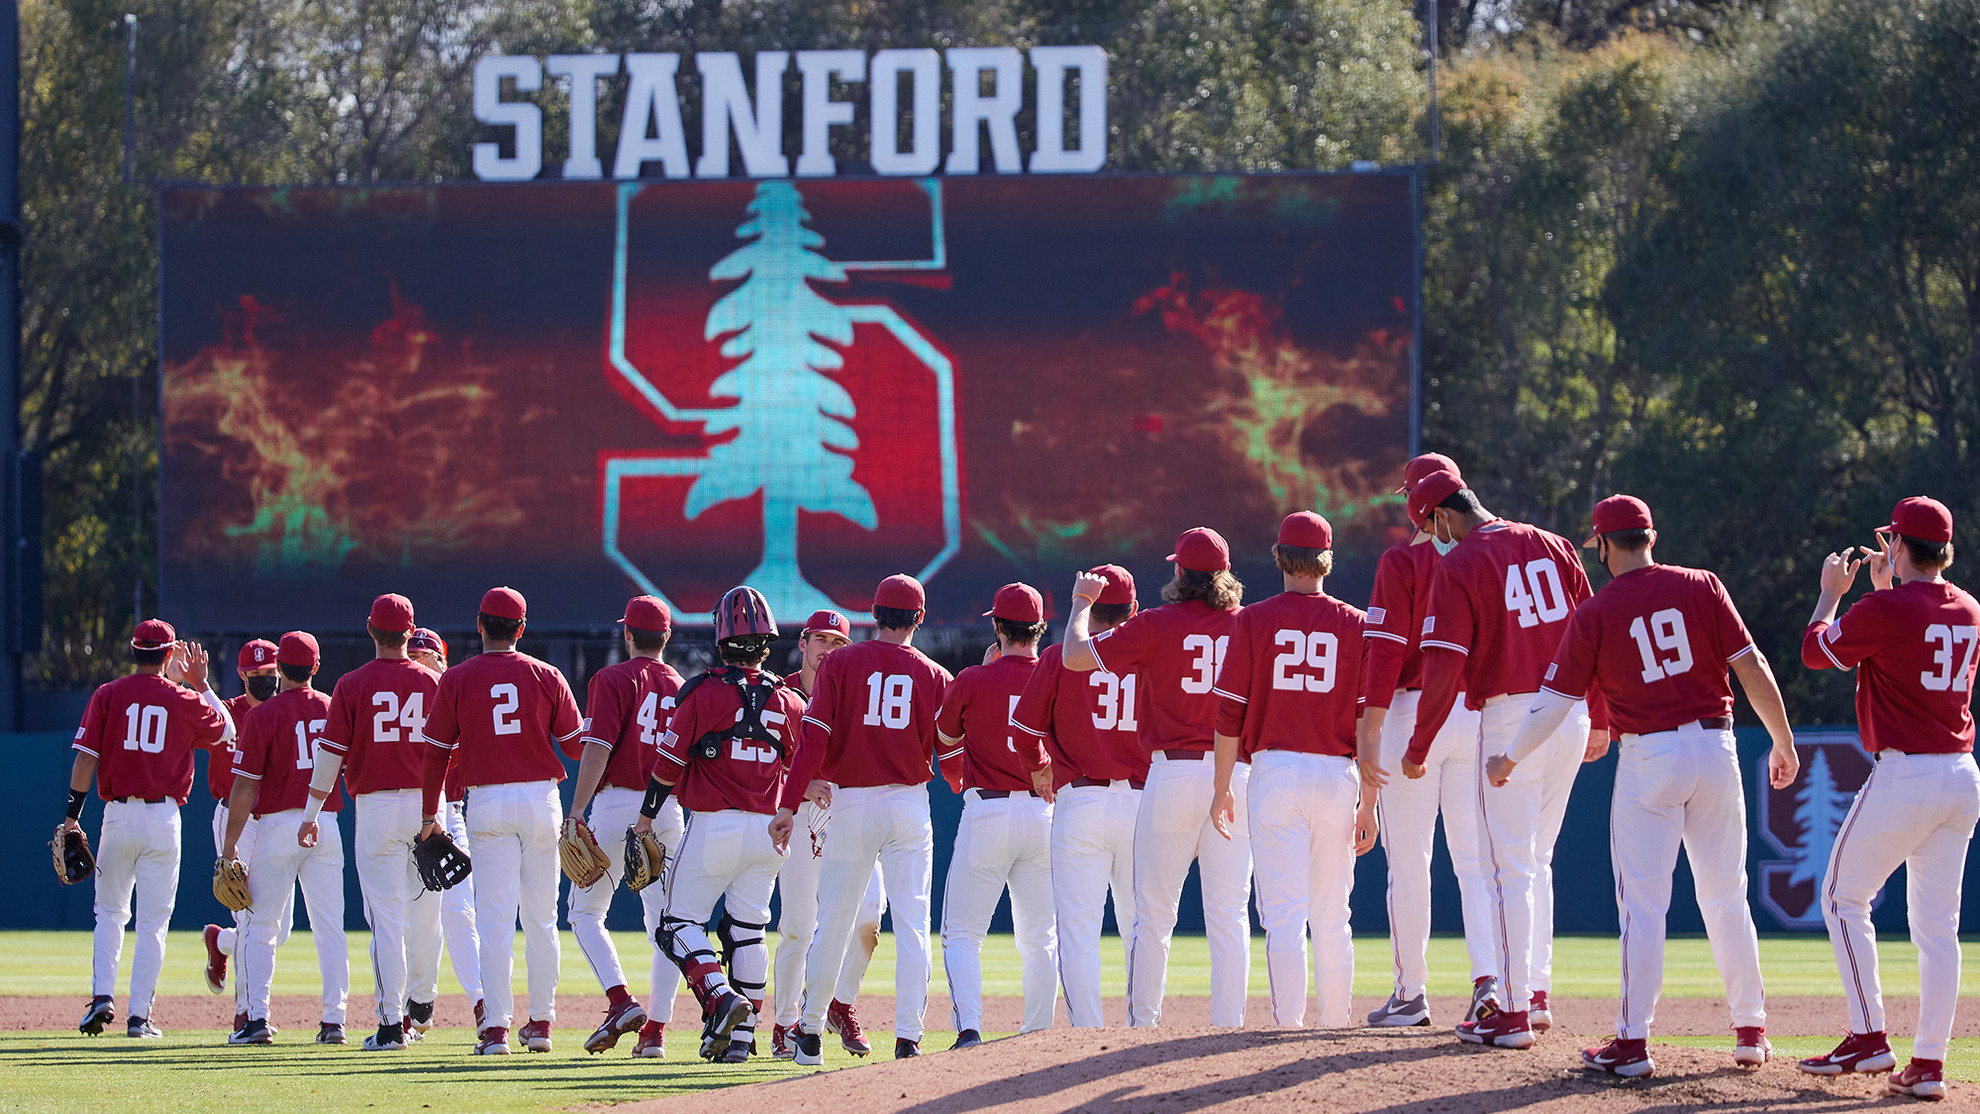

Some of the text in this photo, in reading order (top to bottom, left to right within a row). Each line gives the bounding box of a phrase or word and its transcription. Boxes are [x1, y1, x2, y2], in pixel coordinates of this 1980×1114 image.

[472, 45, 1108, 181] STANFORD
[1504, 557, 1569, 629] 40
[1272, 628, 1339, 694] 29
[1629, 607, 1694, 684] 19
[1920, 623, 1978, 692] 37
[123, 702, 168, 754] 10
[372, 691, 427, 744] 24
[490, 682, 522, 736] 2
[863, 671, 914, 730] 18
[1089, 670, 1138, 732] 31
